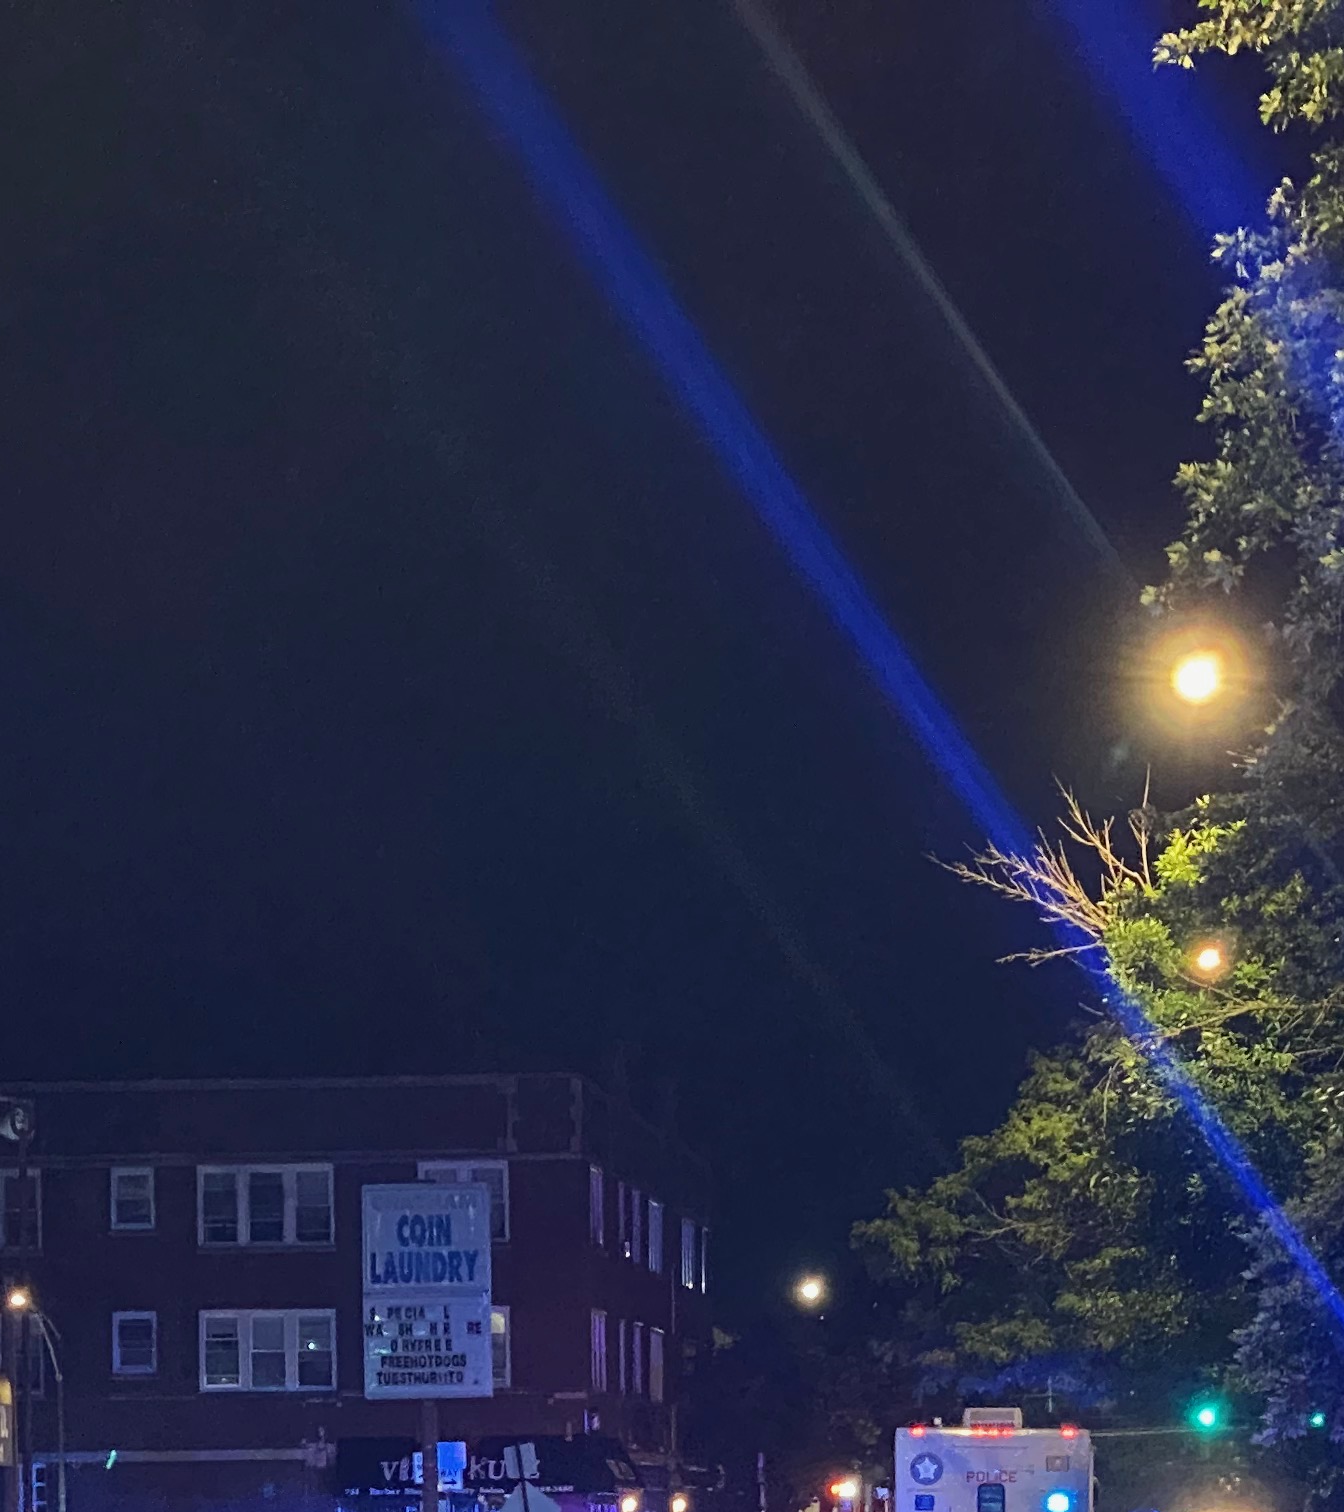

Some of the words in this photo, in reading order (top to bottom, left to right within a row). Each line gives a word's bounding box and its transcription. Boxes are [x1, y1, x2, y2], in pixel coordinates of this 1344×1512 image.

[397, 1214, 452, 1247] COIN
[370, 1250, 478, 1284] LAUNDRY
[966, 1470, 1017, 1483] POLICE
